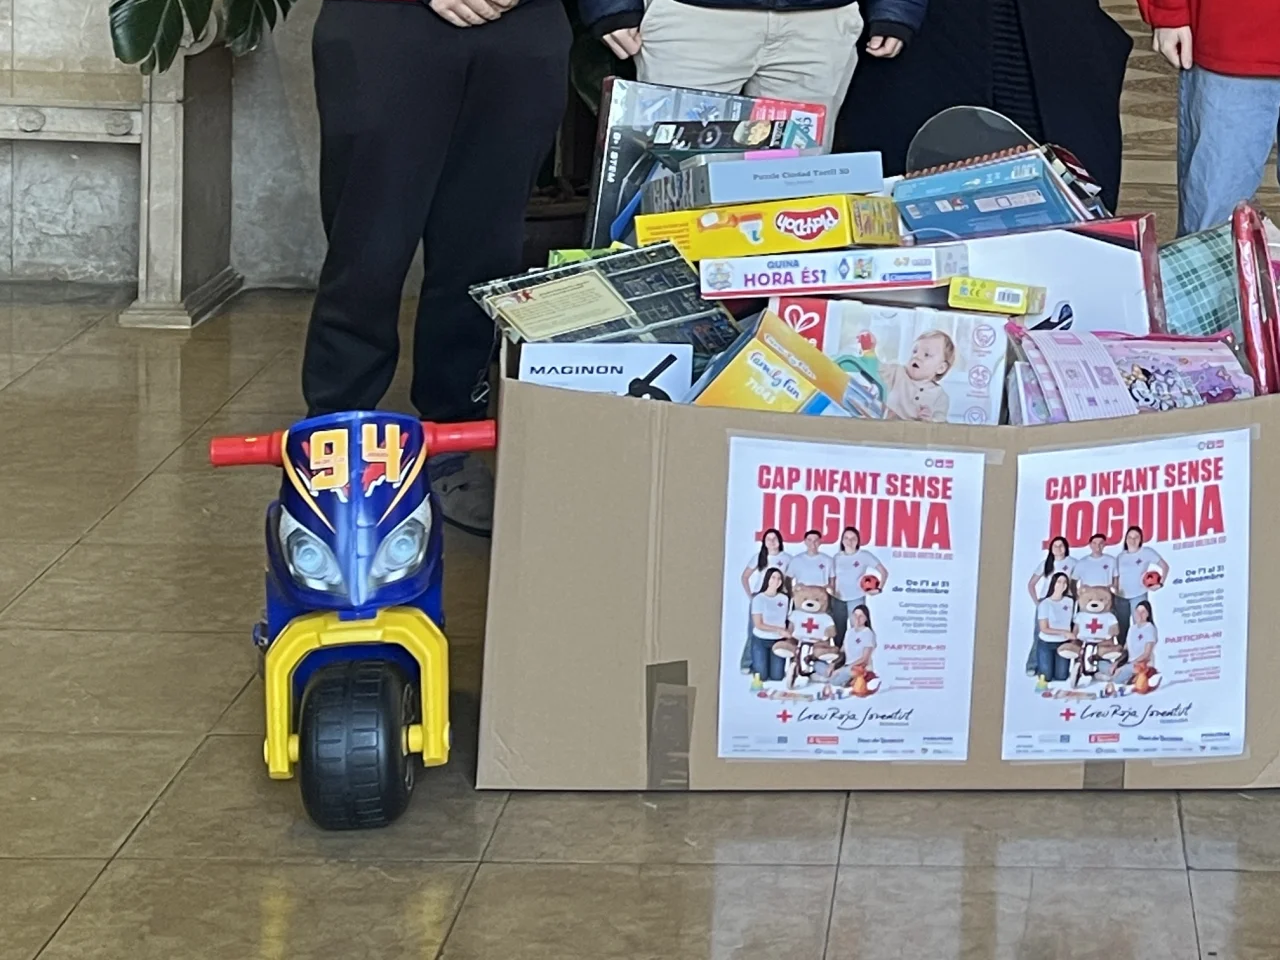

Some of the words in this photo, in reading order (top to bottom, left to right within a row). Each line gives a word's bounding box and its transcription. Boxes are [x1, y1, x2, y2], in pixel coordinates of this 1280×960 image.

[606, 151, 618, 183] STEM
[744, 271, 794, 287] HORA
[800, 267, 827, 284] ÉS?
[766, 259, 800, 270] QUINA
[530, 365, 624, 375] MAGINON
[750, 351, 783, 387] Family
[782, 377, 801, 399] Fun
[309, 424, 401, 491] 94
[758, 465, 800, 490] CAP
[806, 468, 881, 495] INFANT
[886, 473, 953, 500] SENSE
[1045, 474, 1086, 501] CAP
[1091, 465, 1160, 497] INFANT
[1165, 456, 1224, 487] SENSE
[755, 492, 953, 551] JOGUINA
[1042, 484, 1225, 551] JOGUINA
[797, 707, 825, 721] Creu
[828, 707, 858, 726] Roja
[1080, 704, 1109, 720] Creu
[1110, 704, 1139, 722] Roja
